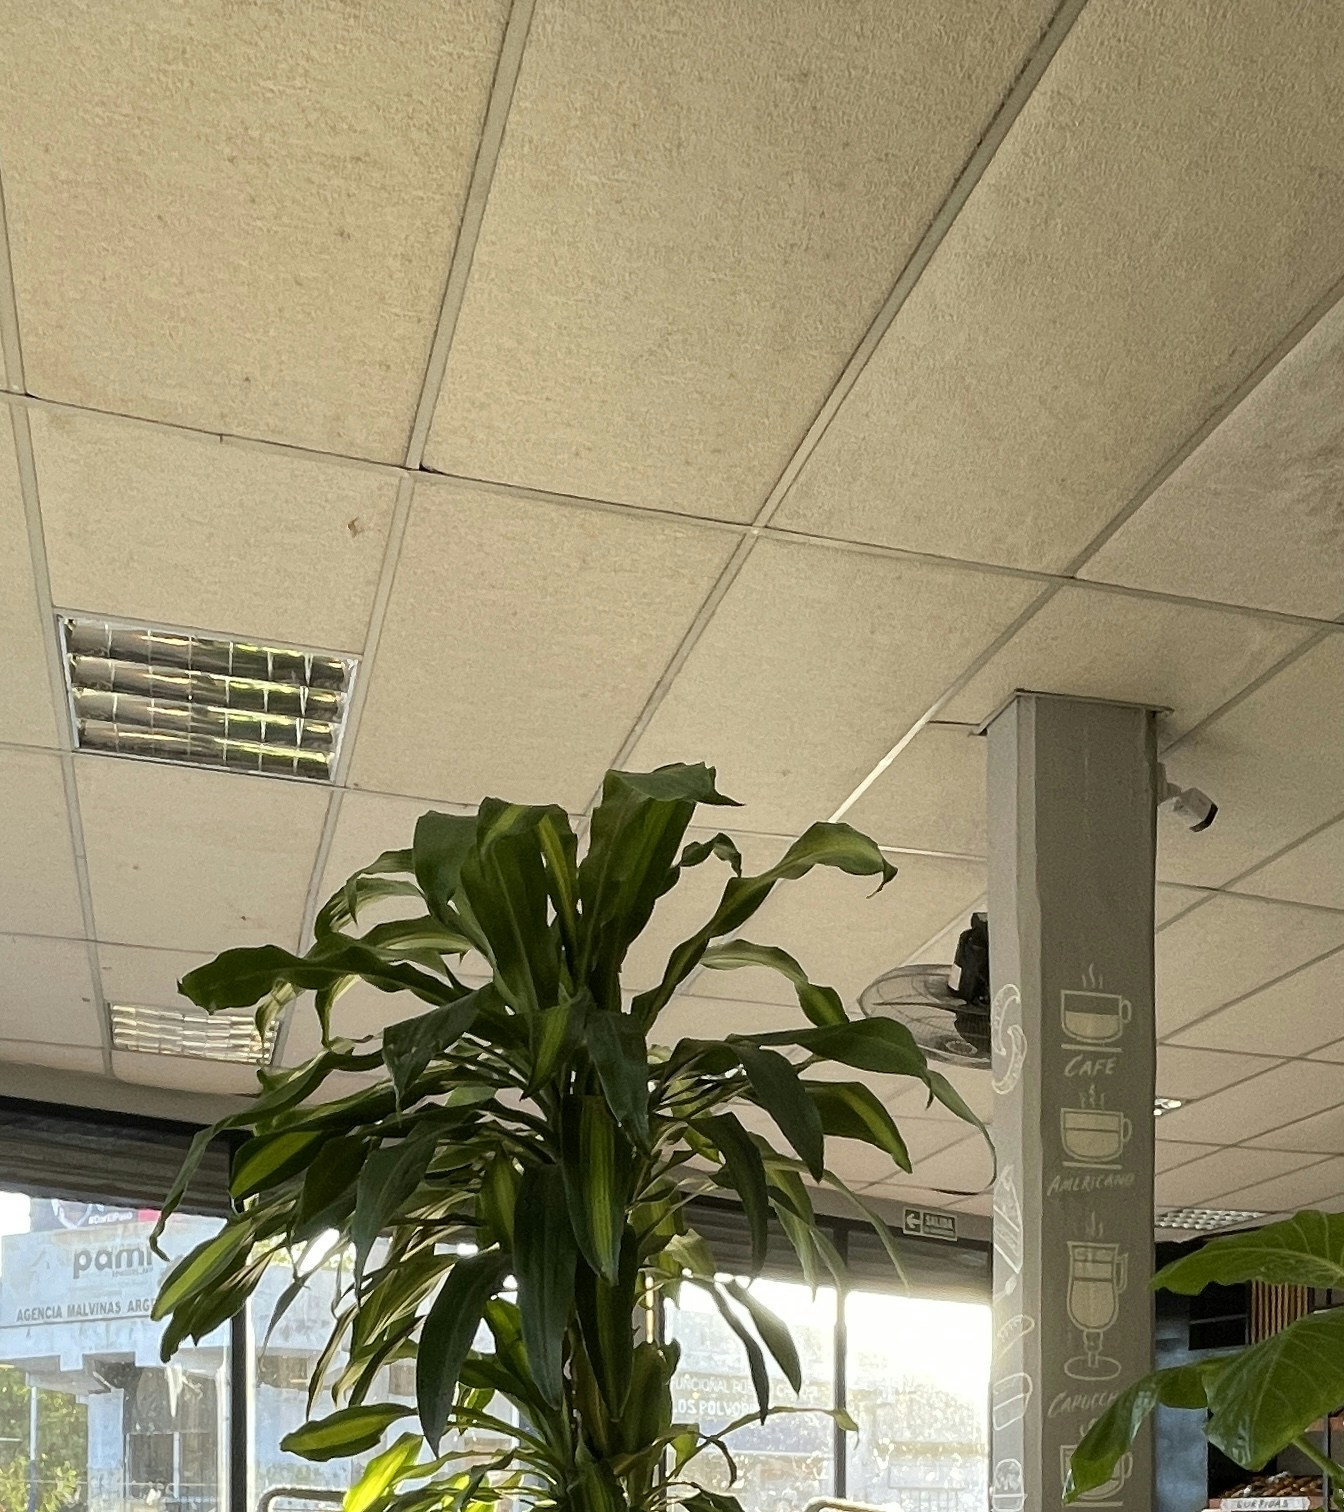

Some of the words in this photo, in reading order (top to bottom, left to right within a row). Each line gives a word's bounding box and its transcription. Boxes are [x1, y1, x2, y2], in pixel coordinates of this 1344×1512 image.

[1064, 1054, 1116, 1077] CAFE
[16, 1305, 63, 1322] AGENCIA
[67, 1300, 121, 1318] MALVINAS
